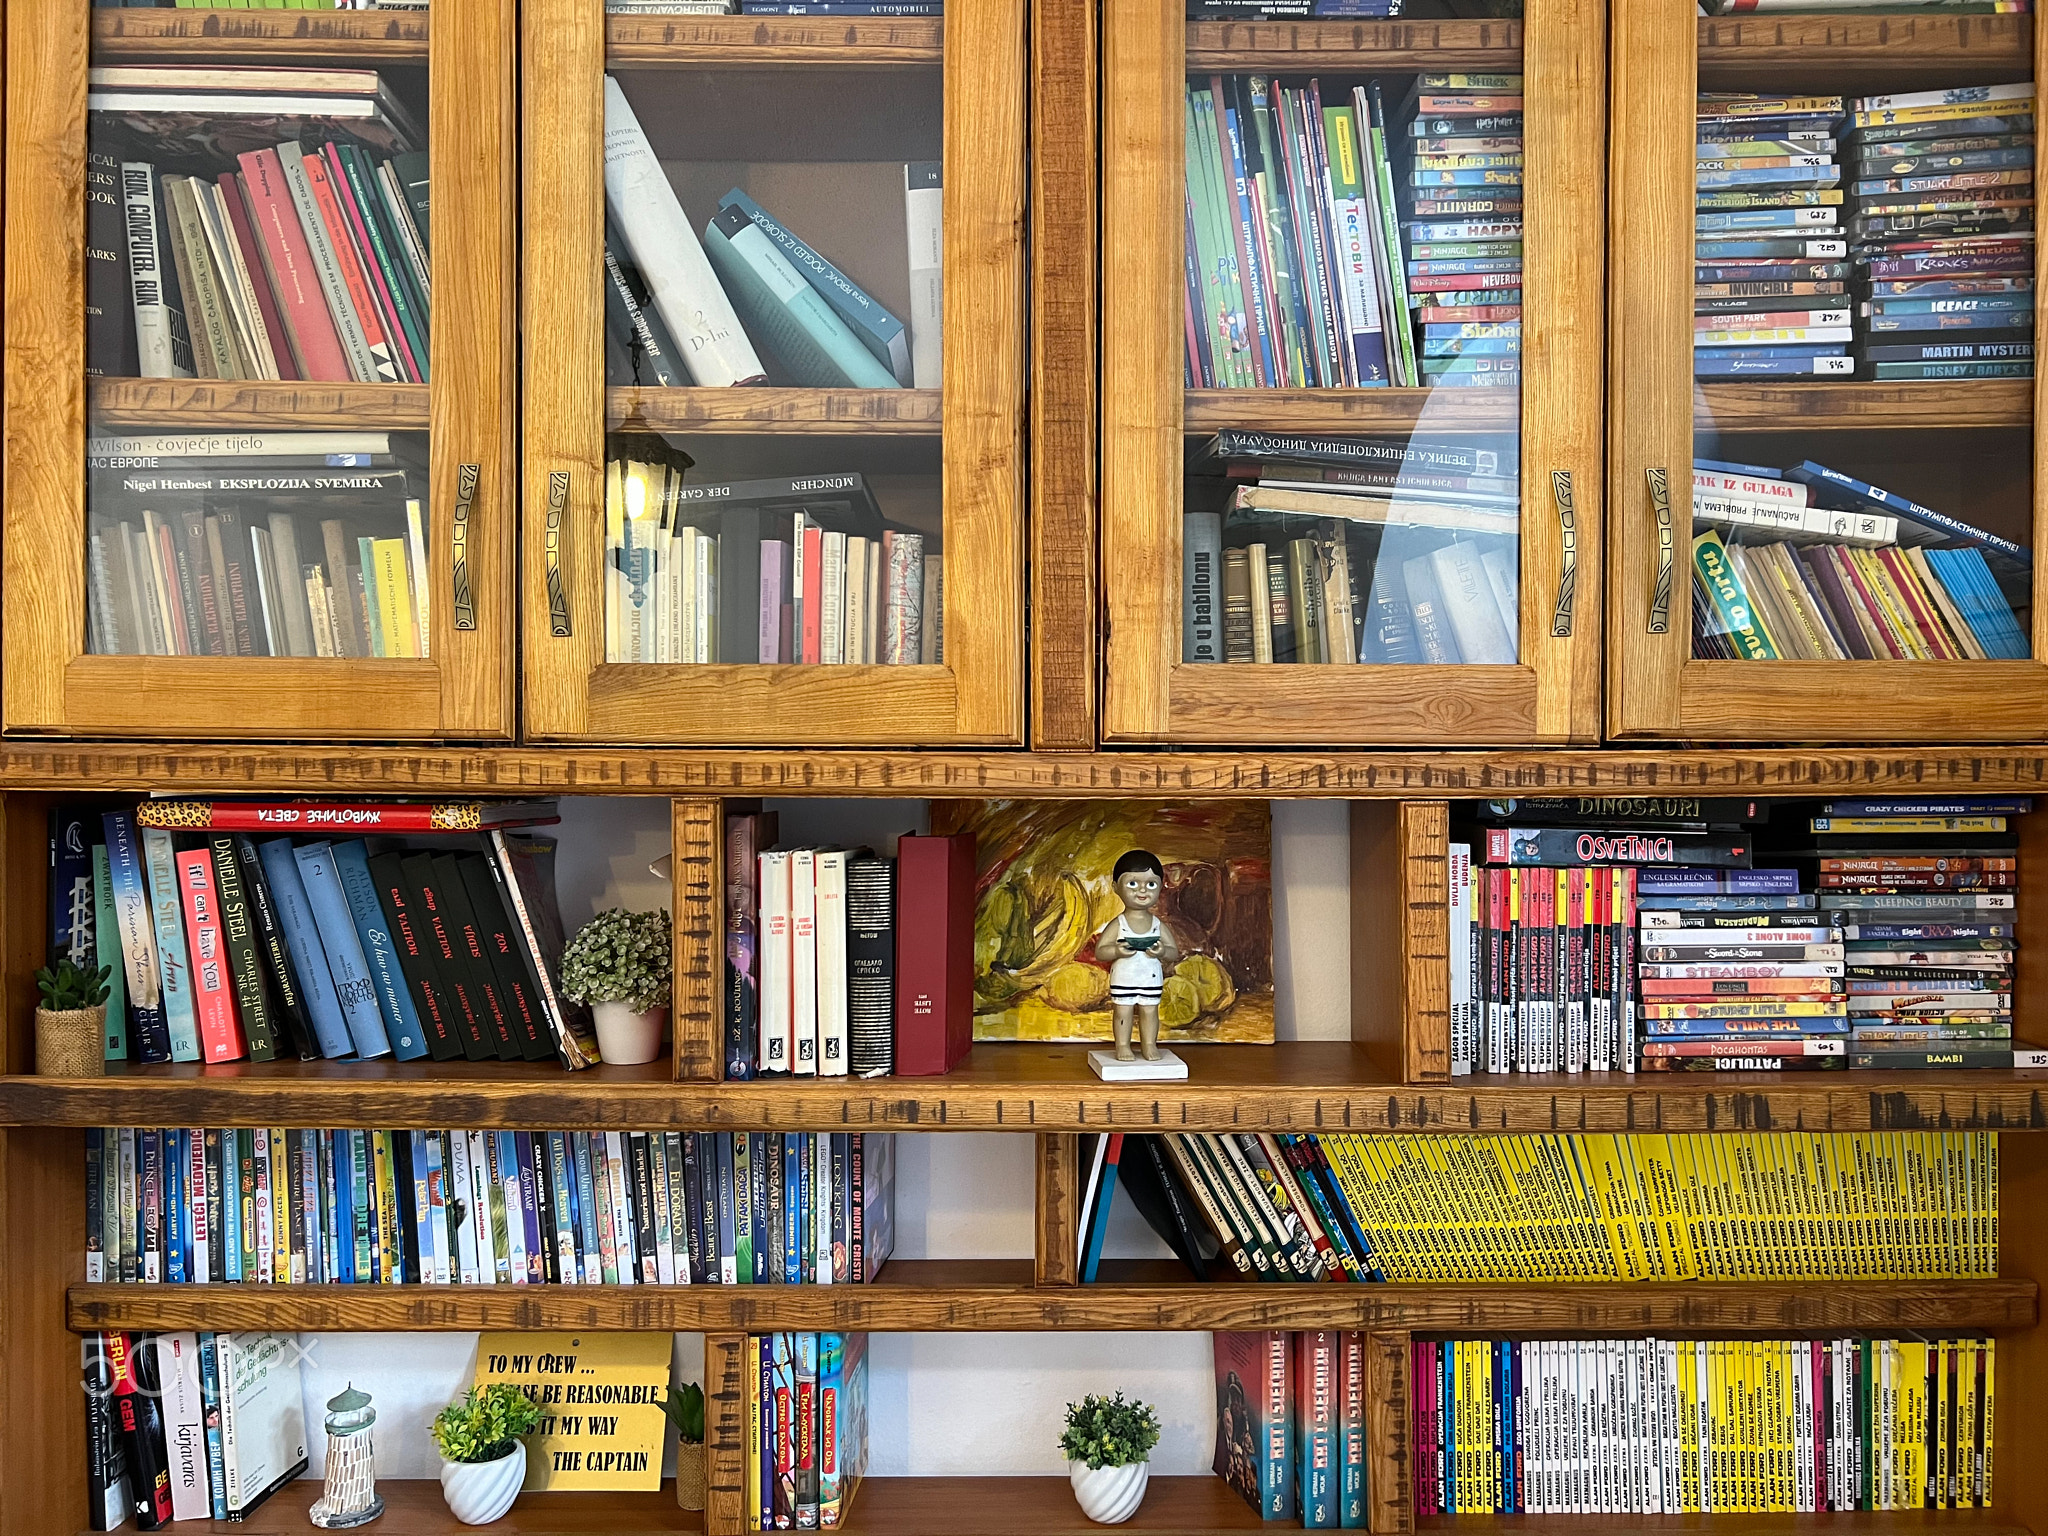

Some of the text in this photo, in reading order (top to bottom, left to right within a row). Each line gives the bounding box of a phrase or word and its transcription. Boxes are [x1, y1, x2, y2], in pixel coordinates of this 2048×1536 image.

[928, 172, 937, 180] 18
[1485, 171, 1518, 184] Shark
[1909, 176, 1987, 191] STUART LITTLE
[1436, 201, 1494, 214] GORMITI
[123, 169, 159, 307] RUN, COMPUTER, RUN
[750, 210, 788, 243] SLOBODE
[1310, 211, 1323, 261] КОЛЕКЦИЈА
[1467, 226, 1522, 237] HAPPY
[270, 203, 305, 305] Computers Processing
[784, 238, 795, 250] IZ
[794, 245, 826, 275] POGLED
[852, 290, 870, 309] Vesna
[1729, 282, 1794, 295] INVINCIBLE
[1321, 297, 1333, 327] УЛТРА
[1711, 313, 1767, 325] SOUTH PARK
[212, 315, 228, 366] KATALOG
[1324, 328, 1339, 364] КАСПЕР
[1922, 346, 1973, 358] MARTIN
[90, 435, 263, 453] Wilson čovječje tijelo
[1231, 434, 1468, 466] ВЕЛИКА ЕНЦИКЛОПЕДИЈА ДИНОСАУРА
[110, 457, 159, 469] ЕВРОПЕ
[123, 477, 383, 492] Nigel Henbest EKSPLOZIJA SVEMIRA
[707, 486, 731, 497] DER
[792, 476, 854, 492] MÜNCHEN
[1723, 479, 1794, 498] IZ GULAGA
[1704, 502, 1747, 515] PROBLEMA
[1988, 534, 2020, 553] ПРИЧЕ!
[389, 584, 399, 638] MATHEMATISCHE
[849, 608, 857, 644] INSTITUCIJA
[257, 809, 382, 824] ЖИВОТИЊЕ СВЕТА
[114, 816, 134, 894] BENEATH THE
[1576, 834, 1674, 862] OSVETNICI
[314, 864, 323, 876] 2
[1451, 853, 1459, 907] DIVLJA HORDA
[1643, 872, 1715, 881] ENGLESKI REČNIK
[1841, 875, 1878, 885] NINJAGO
[1842, 861, 1879, 871] NINJAGO
[214, 837, 246, 942] DANIELLE STEEL
[358, 869, 377, 913] ALYSON
[1874, 896, 1963, 908] SLEEPING BEAUTY
[391, 888, 419, 957] MOLITVA prva
[423, 887, 454, 959] MOLITVA druga
[1755, 932, 1812, 942] HOME ALONE
[194, 894, 219, 992] can't have You
[463, 924, 482, 959] SUDIJA
[1685, 966, 1784, 978] STEAMBOY
[242, 948, 266, 1029] CHARLES STREET
[734, 971, 743, 1013] ROULING
[1451, 1002, 1459, 1063] ZAGOR SPECIJAL
[1725, 1020, 1801, 1032] THE WILD
[1710, 1044, 1768, 1056] POCAHONTAS
[1926, 1054, 1963, 1063] BAMBI
[225, 1165, 233, 1184] LOVE
[453, 1142, 465, 1185] DUMA
[534, 1144, 545, 1203] CRAZY CHICKEN
[768, 1144, 779, 1211] DINOSAUR
[207, 1161, 219, 1196] Harry
[834, 1153, 843, 1230] LION KING
[853, 1132, 862, 1241] THE COUNT OF MONTE
[226, 1185, 235, 1221] FABULOUS
[558, 1188, 569, 1223] Heaven
[670, 1171, 683, 1236] EL DORADO
[739, 1201, 749, 1238] PATAK
[228, 1237, 236, 1254] AND
[1317, 1332, 1325, 1342] 2
[109, 1330, 128, 1381] BERLIN
[488, 1353, 577, 1374] TO MY CREW
[541, 1384, 564, 1404] BE
[566, 1384, 659, 1405] REASONABLE
[119, 1398, 137, 1433] GEM
[540, 1415, 619, 1436] IT MY WAY
[800, 1391, 811, 1461] ТРИ МУСКЕТАРА
[210, 1440, 224, 1500] КОЛИН ГУВЕР
[553, 1451, 648, 1472] THE CAPTAIN
[1437, 1450, 1445, 1508] ALAN FORD
